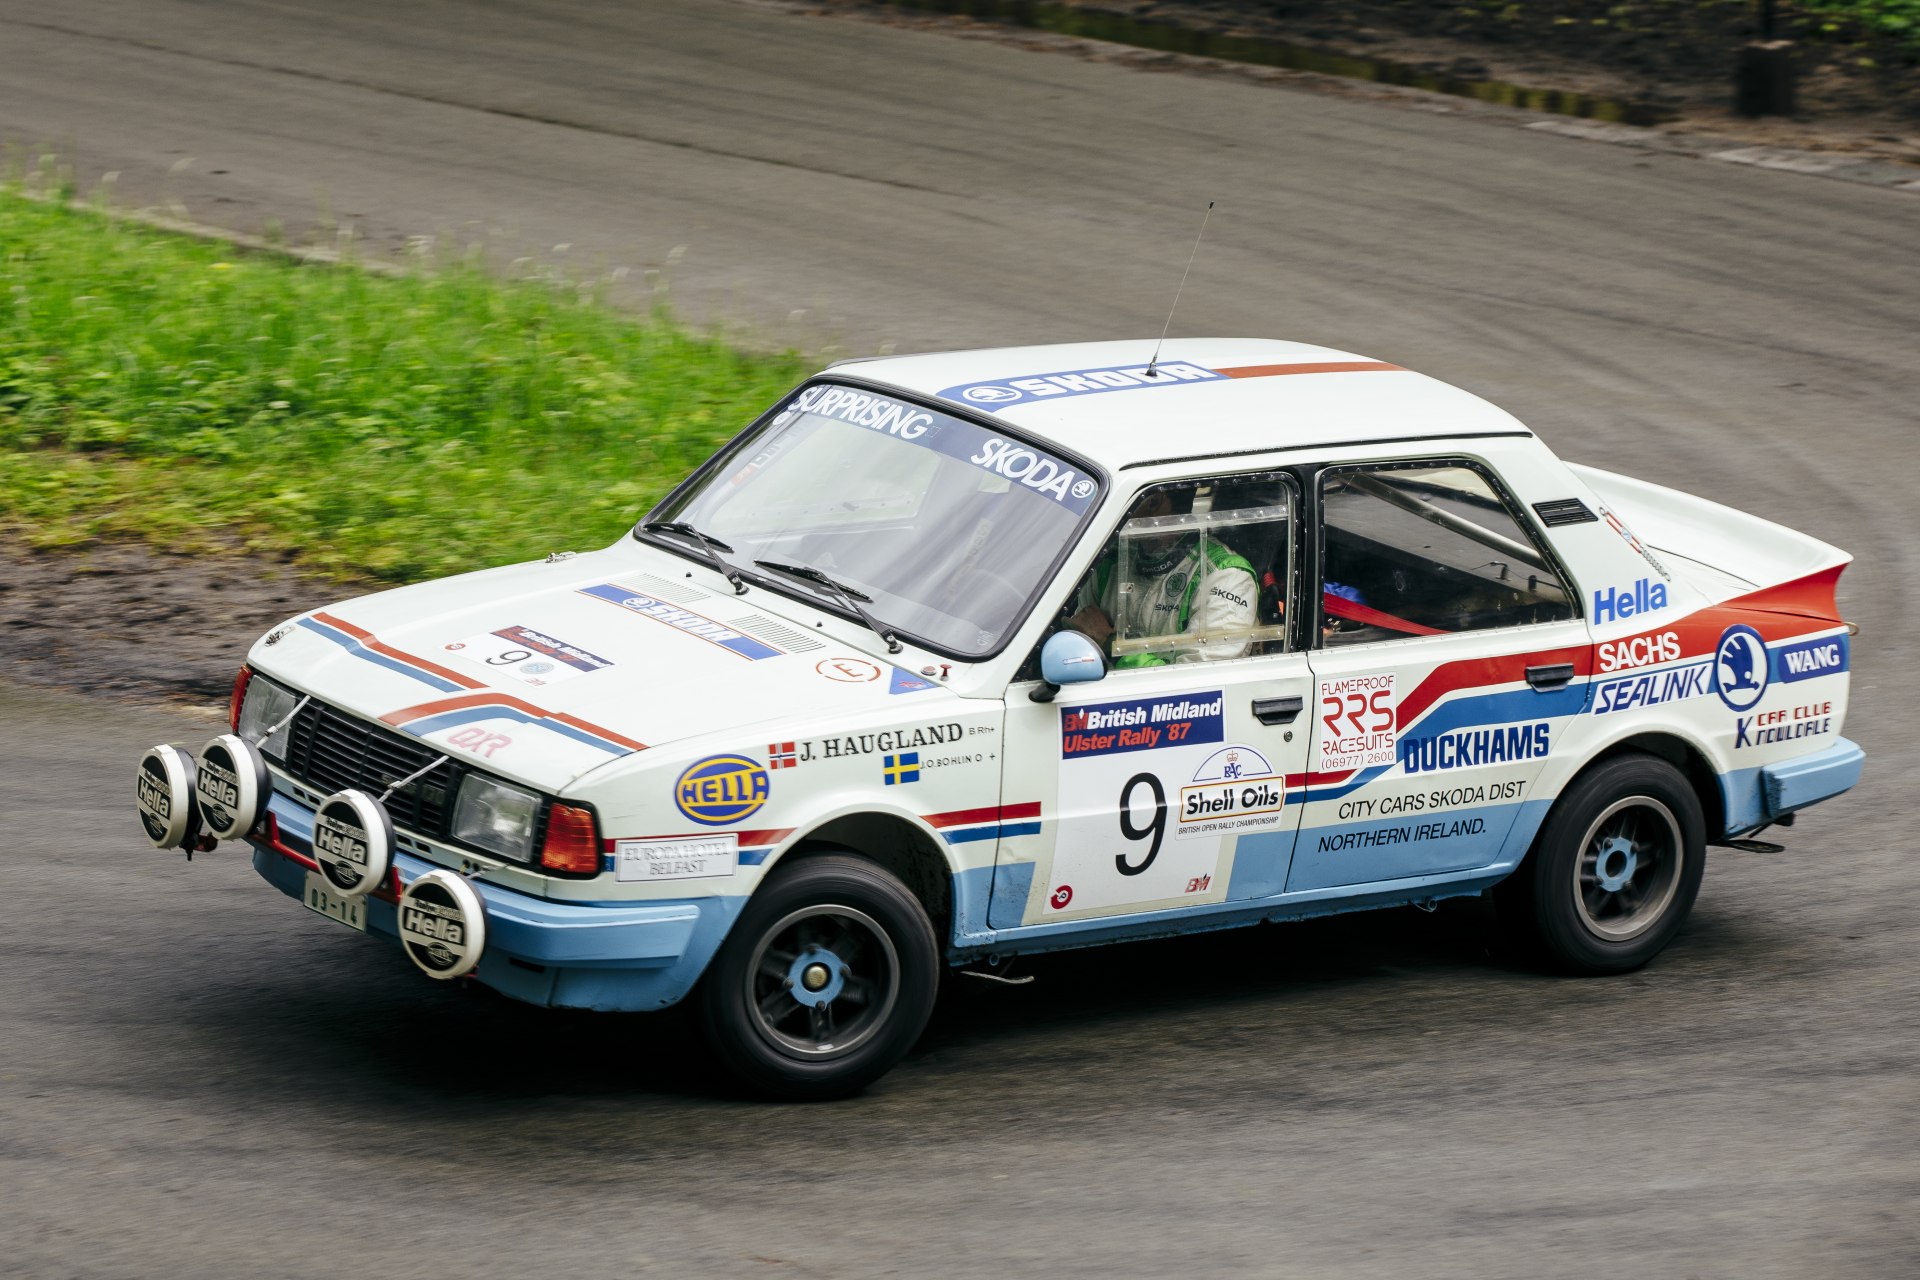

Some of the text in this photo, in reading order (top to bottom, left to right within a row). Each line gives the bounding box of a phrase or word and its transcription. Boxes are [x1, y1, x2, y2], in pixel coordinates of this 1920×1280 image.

[787, 386, 933, 439] SURPRISING
[971, 438, 1075, 501] SKODA
[1209, 586, 1249, 608] ŠKODA
[1593, 577, 1668, 625] Hella
[485, 650, 532, 665] 9
[832, 663, 864, 677] E
[1599, 632, 1682, 673] SACHS
[1784, 644, 1840, 675] WANG
[1321, 675, 1395, 696] FLAMEPROOF
[1594, 664, 1714, 716] SEALINK
[1086, 706, 1148, 730] British
[1151, 698, 1222, 723] Midland
[1322, 690, 1394, 737] RRS
[799, 741, 816, 763] J.
[823, 722, 963, 759] HAUGLAND
[1062, 734, 1116, 753] Ulster
[1118, 727, 1162, 747] Rally
[1322, 733, 1394, 755] RACESUITS
[1403, 723, 1550, 774] DUCKHAMS
[1321, 751, 1394, 770] (06977) 2600
[139, 779, 170, 820] Hella
[199, 770, 238, 808] Hella
[682, 769, 770, 804] HELLA
[1186, 785, 1279, 815] Shell Oils
[1338, 780, 1527, 820] CITY CARS SKODA DIST
[1115, 772, 1168, 877] 9
[1178, 816, 1279, 835] BRITISH OPEN RALLY CHAMPIONSHIP
[1318, 818, 1486, 853] NORTHERN IRELAND.
[318, 826, 366, 864] Hella
[405, 908, 463, 944] Hella
